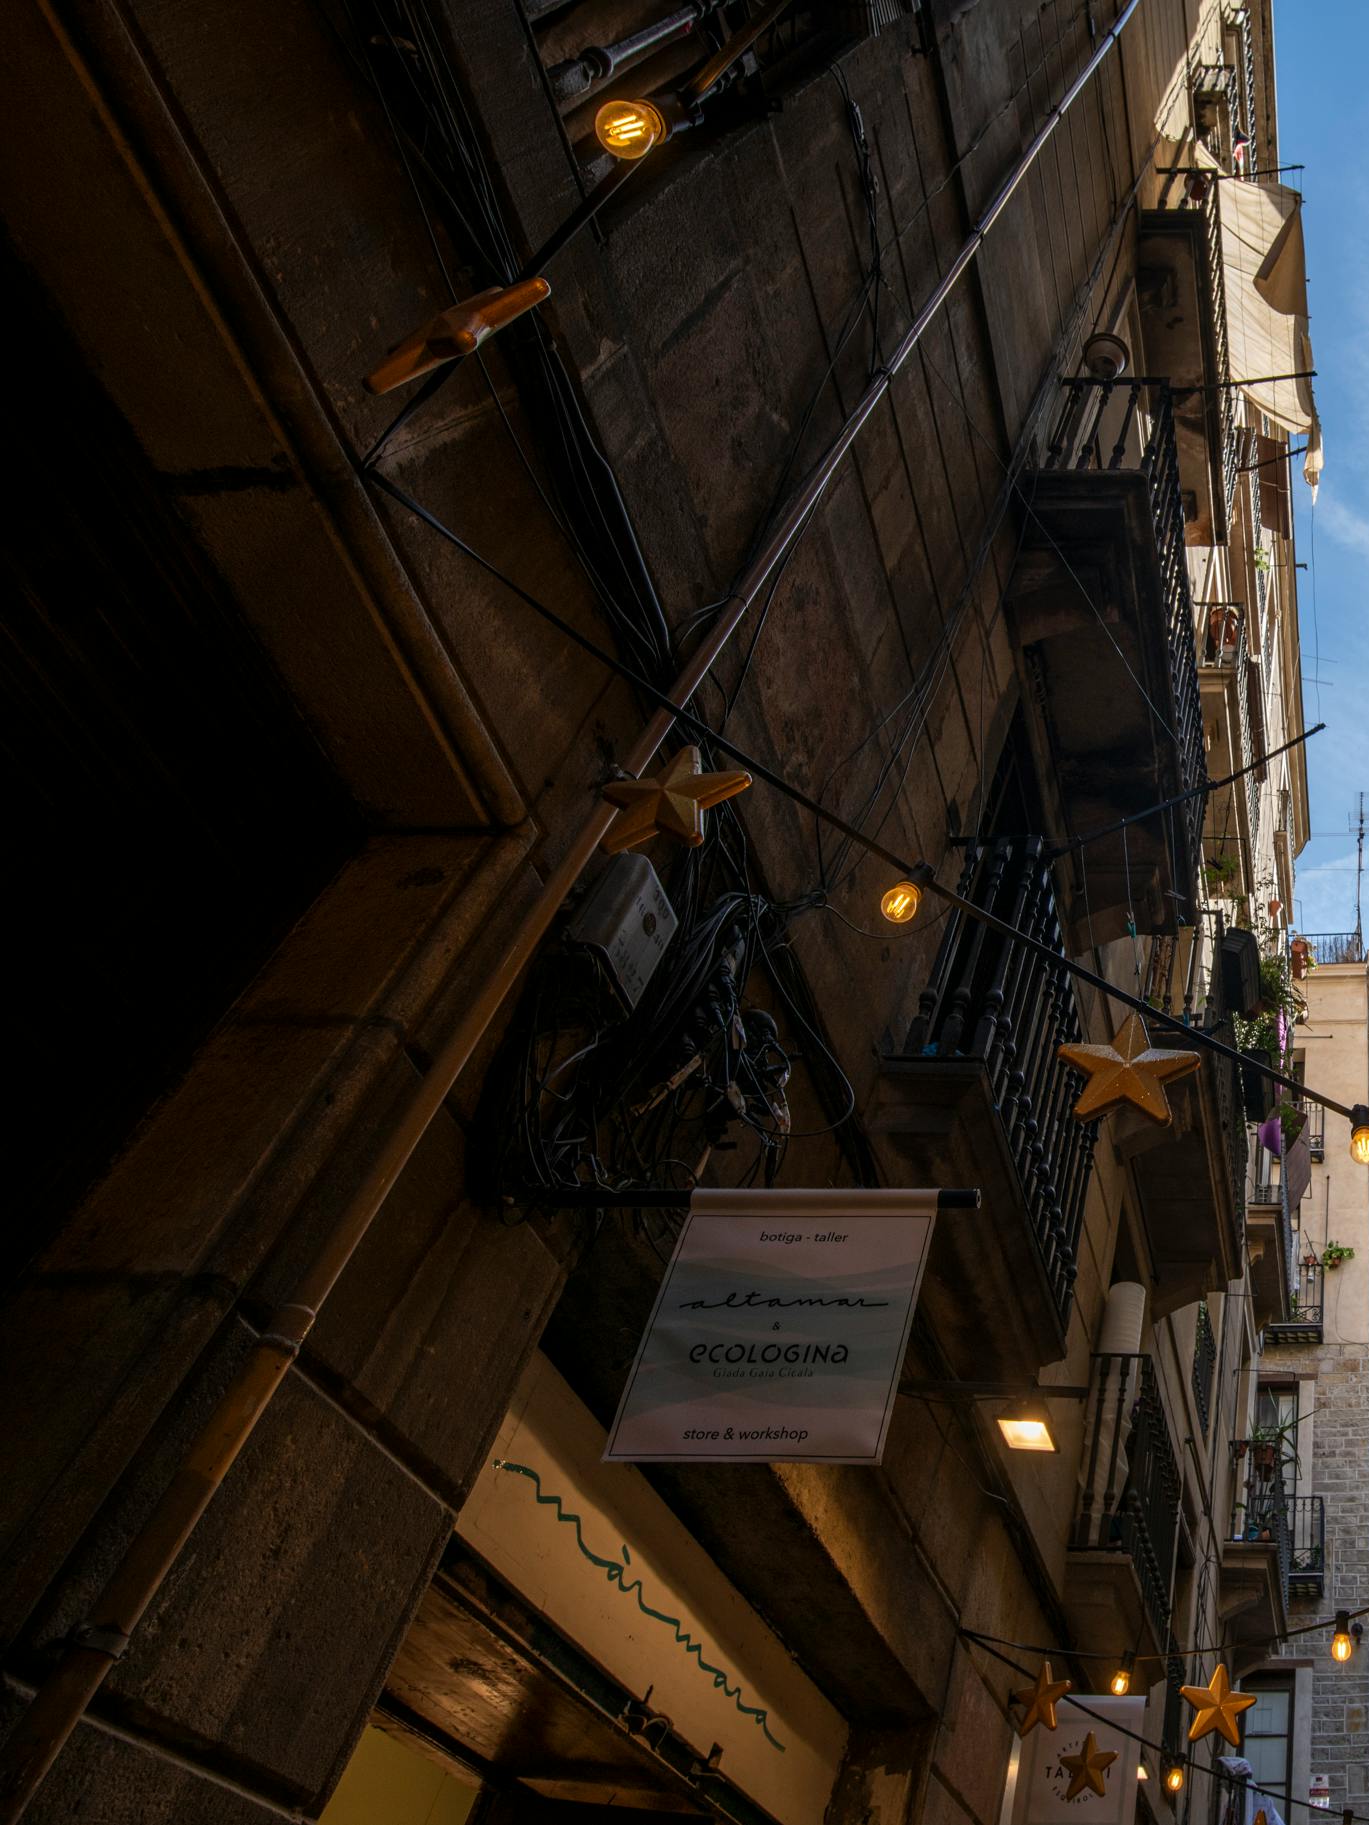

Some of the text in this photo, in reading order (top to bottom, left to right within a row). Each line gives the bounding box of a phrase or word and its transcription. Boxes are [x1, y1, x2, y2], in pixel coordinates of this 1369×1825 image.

[759, 1231, 802, 1245] botiga
[814, 1231, 849, 1242] taller
[679, 1291, 889, 1309] altamar
[772, 1321, 781, 1331] &
[682, 1426, 809, 1443] store & workshop
